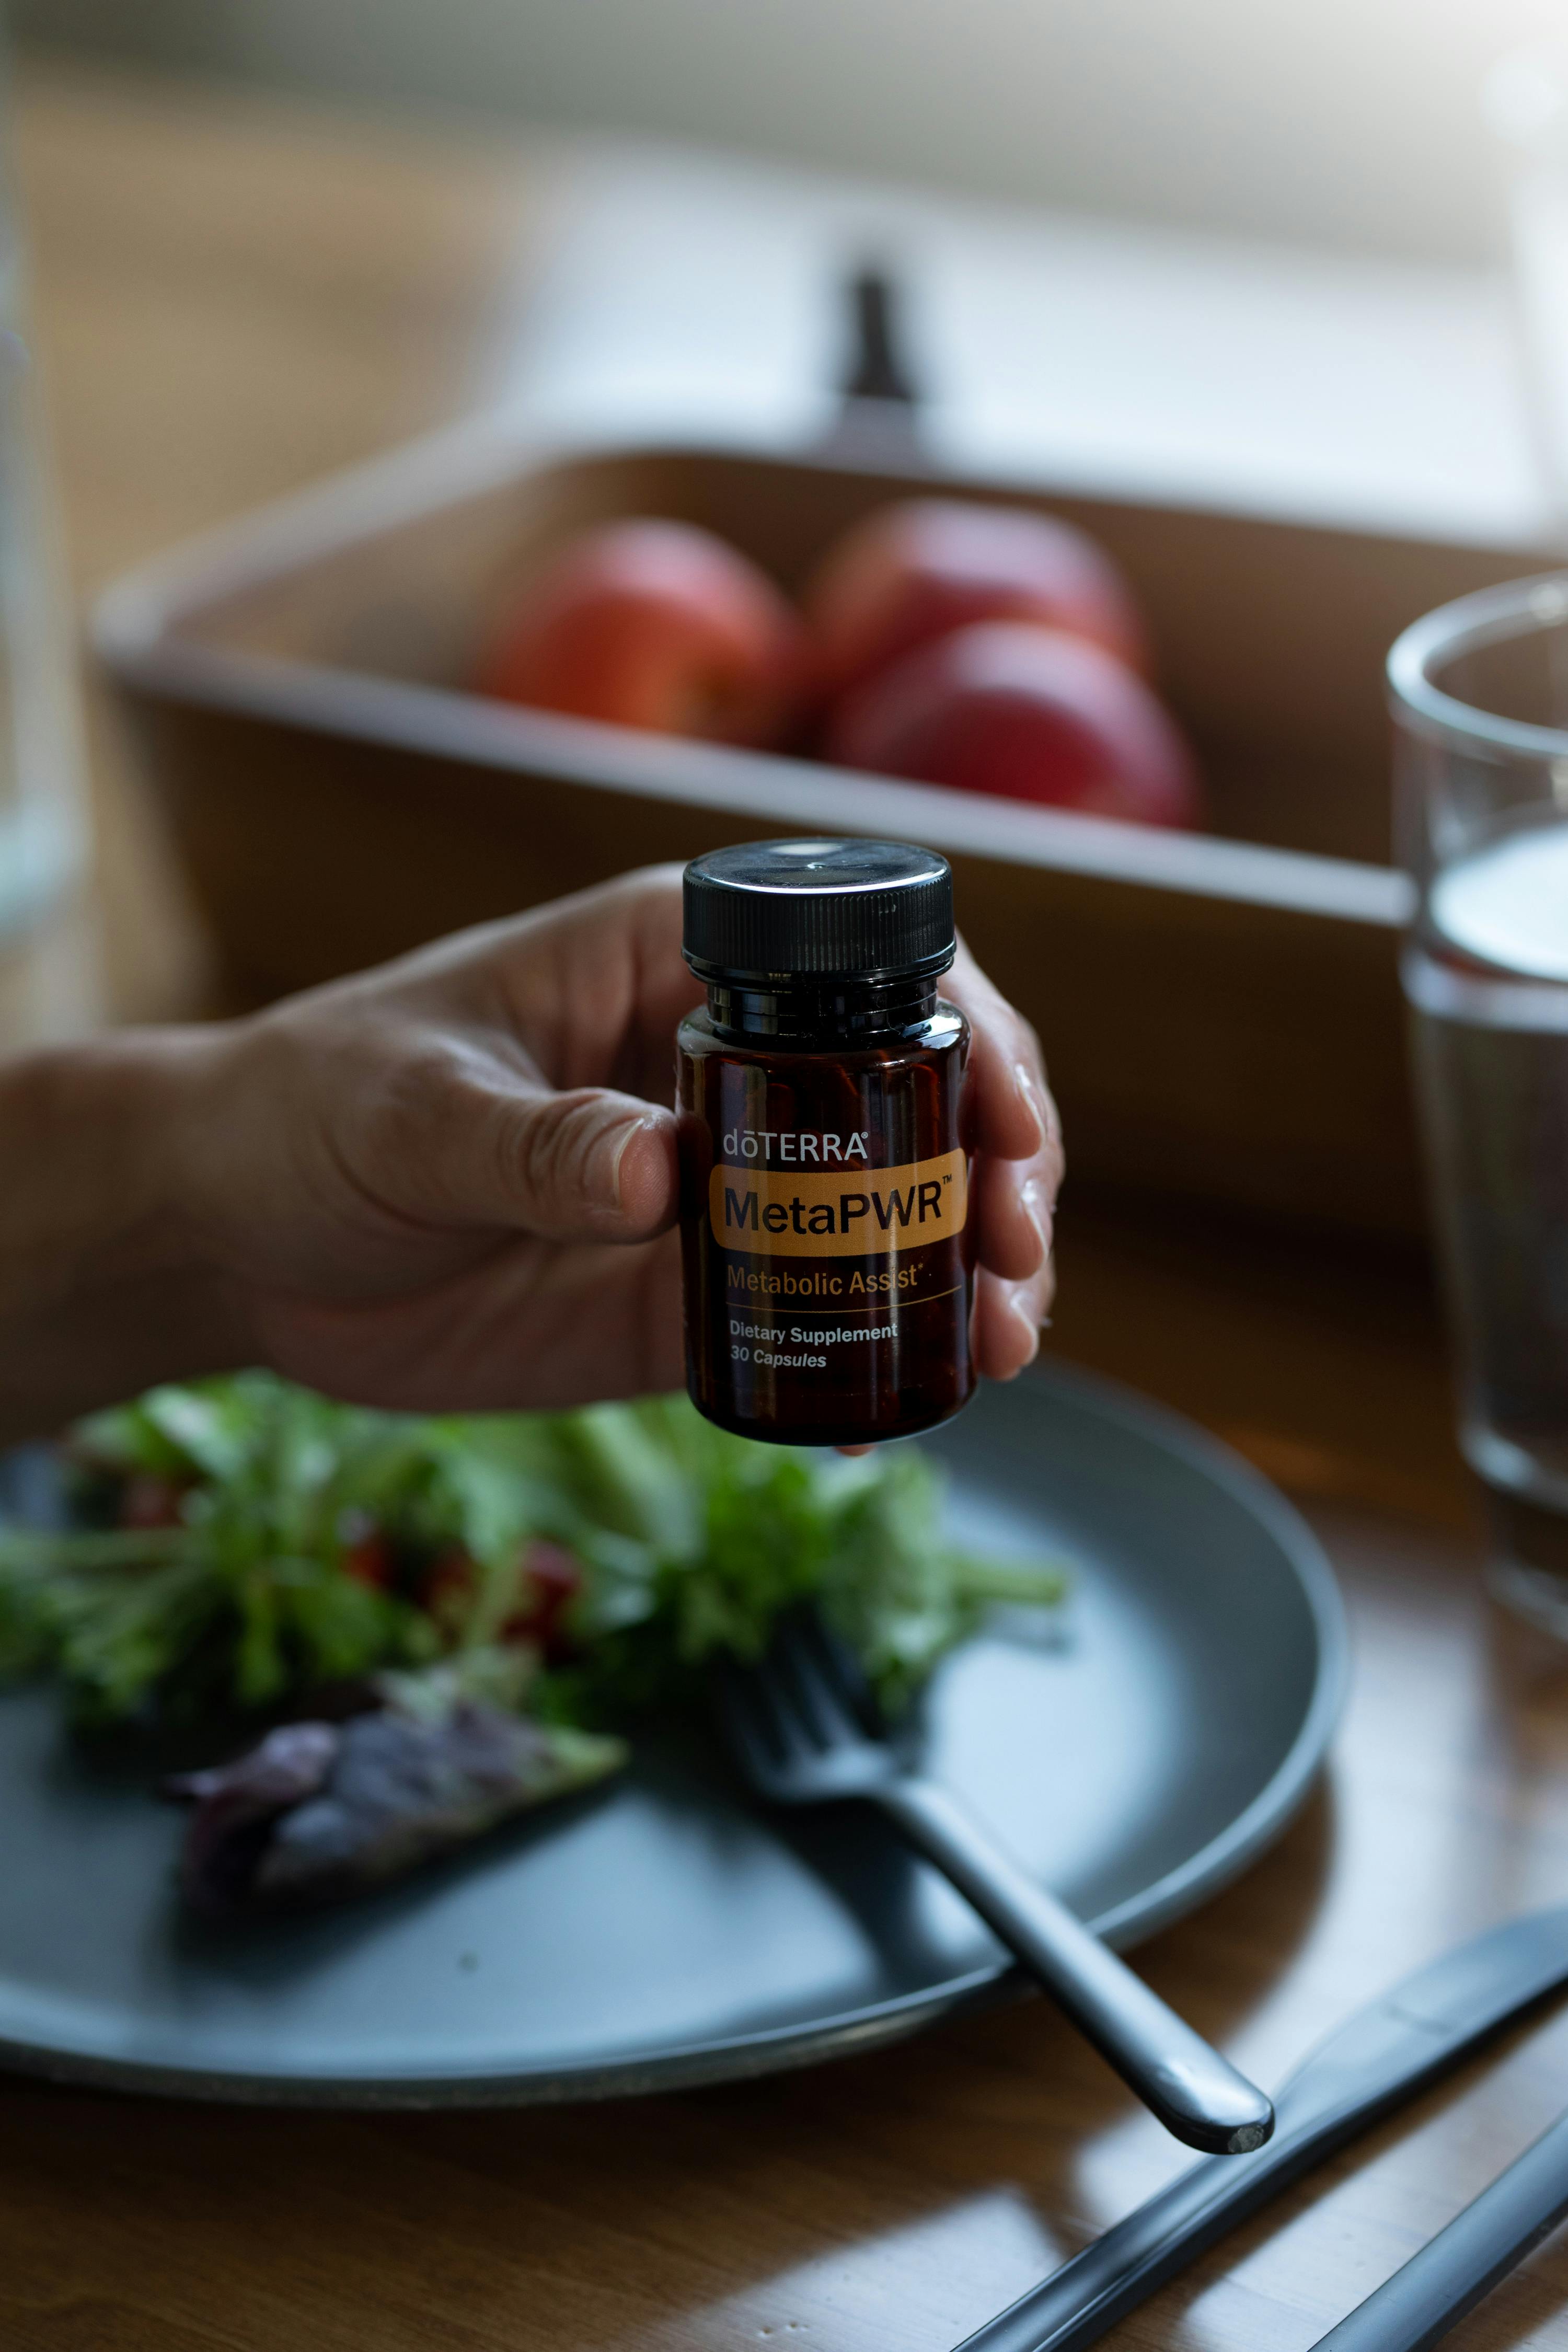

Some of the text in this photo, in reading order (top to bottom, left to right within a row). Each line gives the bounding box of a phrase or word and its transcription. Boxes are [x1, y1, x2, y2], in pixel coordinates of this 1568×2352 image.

[727, 1265, 843, 1295] Metabolic
[730, 1320, 898, 1346] Dietary Supplement
[731, 1345, 827, 1368] 30 Capsules
